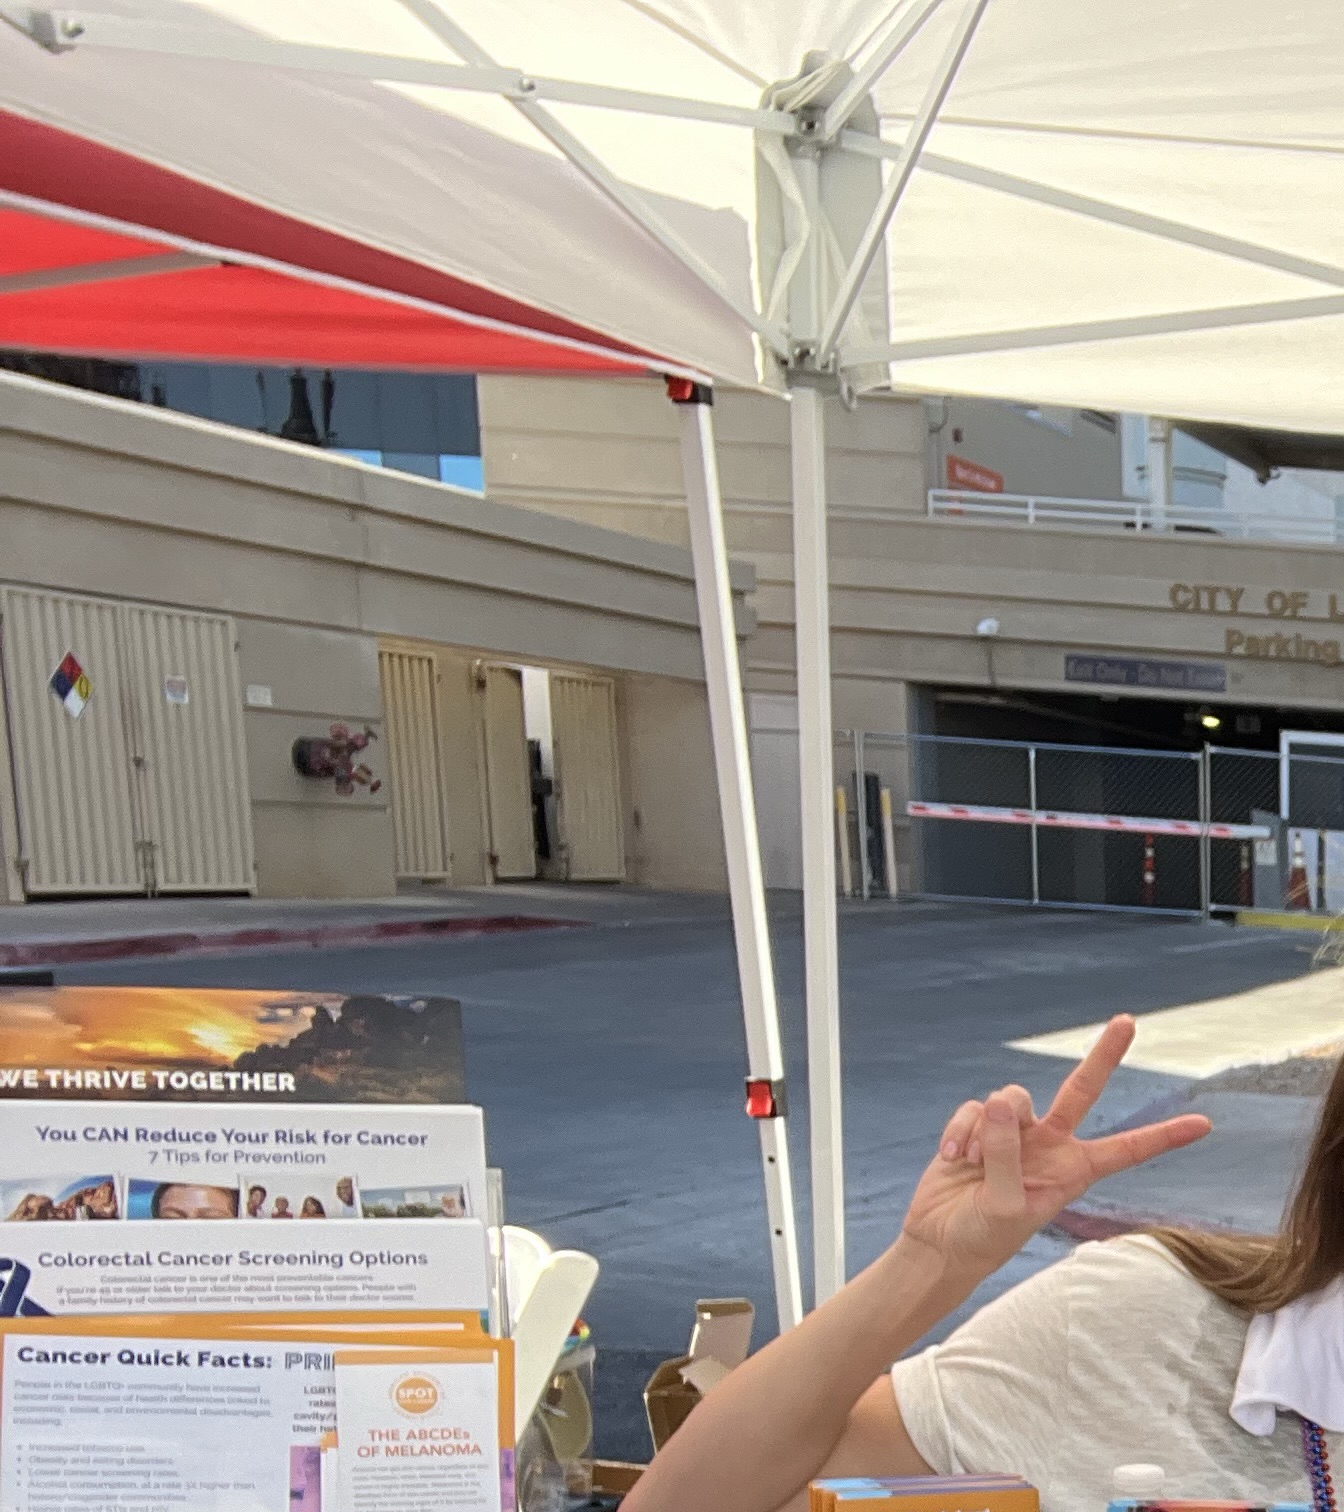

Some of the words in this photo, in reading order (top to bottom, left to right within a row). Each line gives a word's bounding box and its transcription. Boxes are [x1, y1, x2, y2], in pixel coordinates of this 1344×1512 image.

[1168, 583, 1245, 614] CITY
[1265, 590, 1309, 618] OF
[1224, 627, 1342, 667] Parking
[0, 1068, 38, 1089] WE
[44, 1069, 147, 1090] THRIVE
[152, 1070, 297, 1093] TOGETHER
[36, 1125, 77, 1142] You
[83, 1127, 129, 1143] CAN
[135, 1128, 218, 1144] Reduce
[222, 1128, 270, 1144] Your
[275, 1129, 317, 1145] Risk
[323, 1129, 352, 1145] for
[357, 1130, 429, 1146] Cancer
[149, 1151, 158, 1165] 7
[163, 1149, 200, 1166] Tips
[205, 1149, 230, 1164] for
[234, 1150, 326, 1165] Prevention
[38, 1251, 153, 1268] Colorectal
[158, 1251, 233, 1267] Cancer
[238, 1250, 344, 1269] Screening
[349, 1250, 428, 1268] Options
[17, 1346, 112, 1365] Cancer
[117, 1349, 190, 1367] Quick
[197, 1351, 273, 1369] Facts:
[284, 1352, 335, 1371] PRI
[398, 1388, 434, 1399] SPOT
[368, 1429, 400, 1441] THE
[406, 1427, 470, 1441] ABCDEs
[357, 1445, 379, 1458] OF
[385, 1443, 482, 1457] MELANOMA
